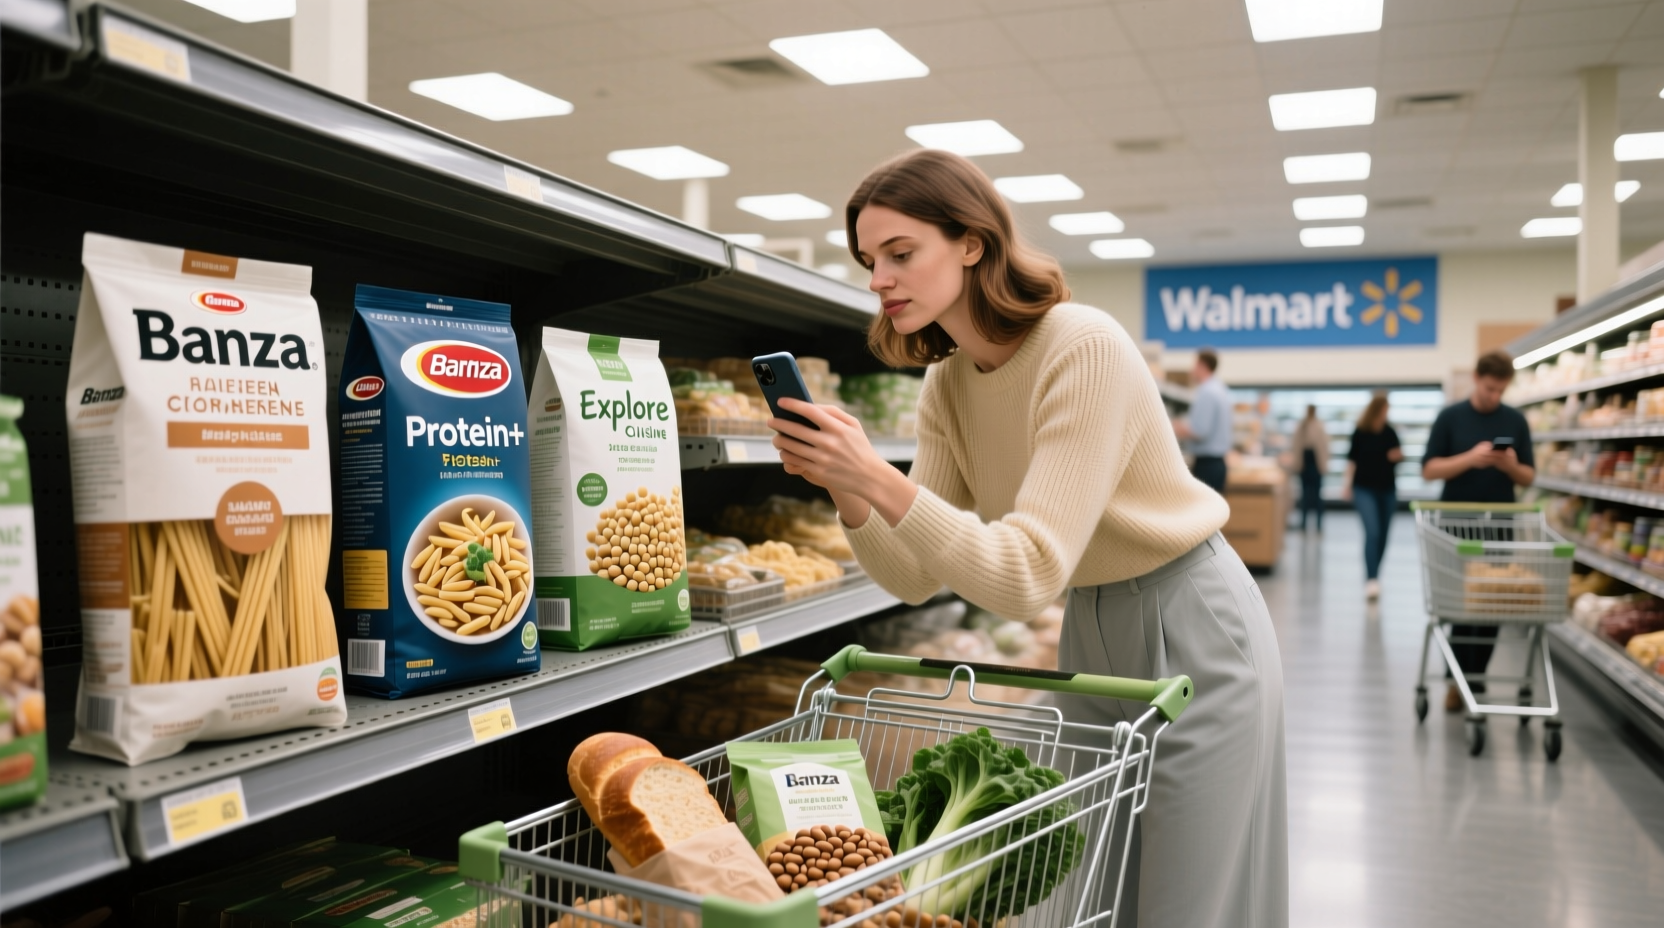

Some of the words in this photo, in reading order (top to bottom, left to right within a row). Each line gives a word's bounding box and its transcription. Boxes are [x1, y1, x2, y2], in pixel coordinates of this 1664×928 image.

[1159, 282, 1353, 331] Walmart
[132, 308, 310, 370] Banza
[406, 416, 525, 448] Protein+
[580, 389, 669, 432] Explore
[785, 773, 840, 787] Banza
